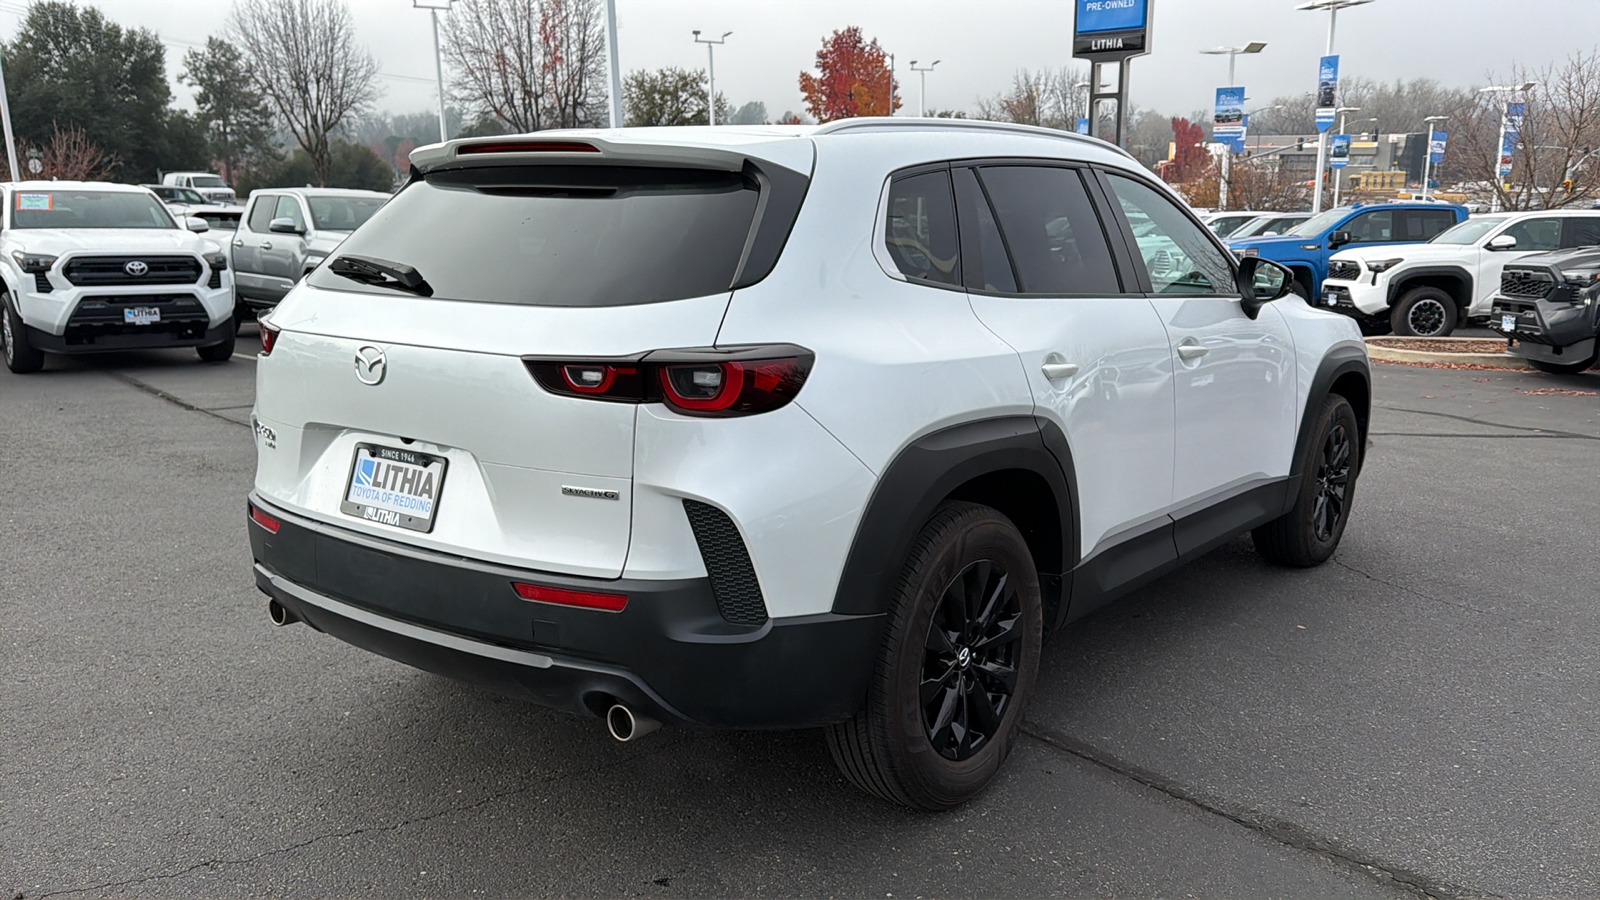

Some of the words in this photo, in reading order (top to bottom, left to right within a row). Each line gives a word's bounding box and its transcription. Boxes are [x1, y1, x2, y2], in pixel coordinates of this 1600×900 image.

[1086, 0, 1135, 11] PRE-OWNED
[1091, 38, 1123, 50] LITHIA
[381, 449, 399, 460] SINCE
[401, 452, 415, 462] 1946
[372, 462, 433, 500] LITHIA
[353, 486, 380, 502] TOYOTA
[382, 492, 392, 503] OF
[393, 495, 431, 512] REDDING
[372, 508, 400, 526] LITHIA
